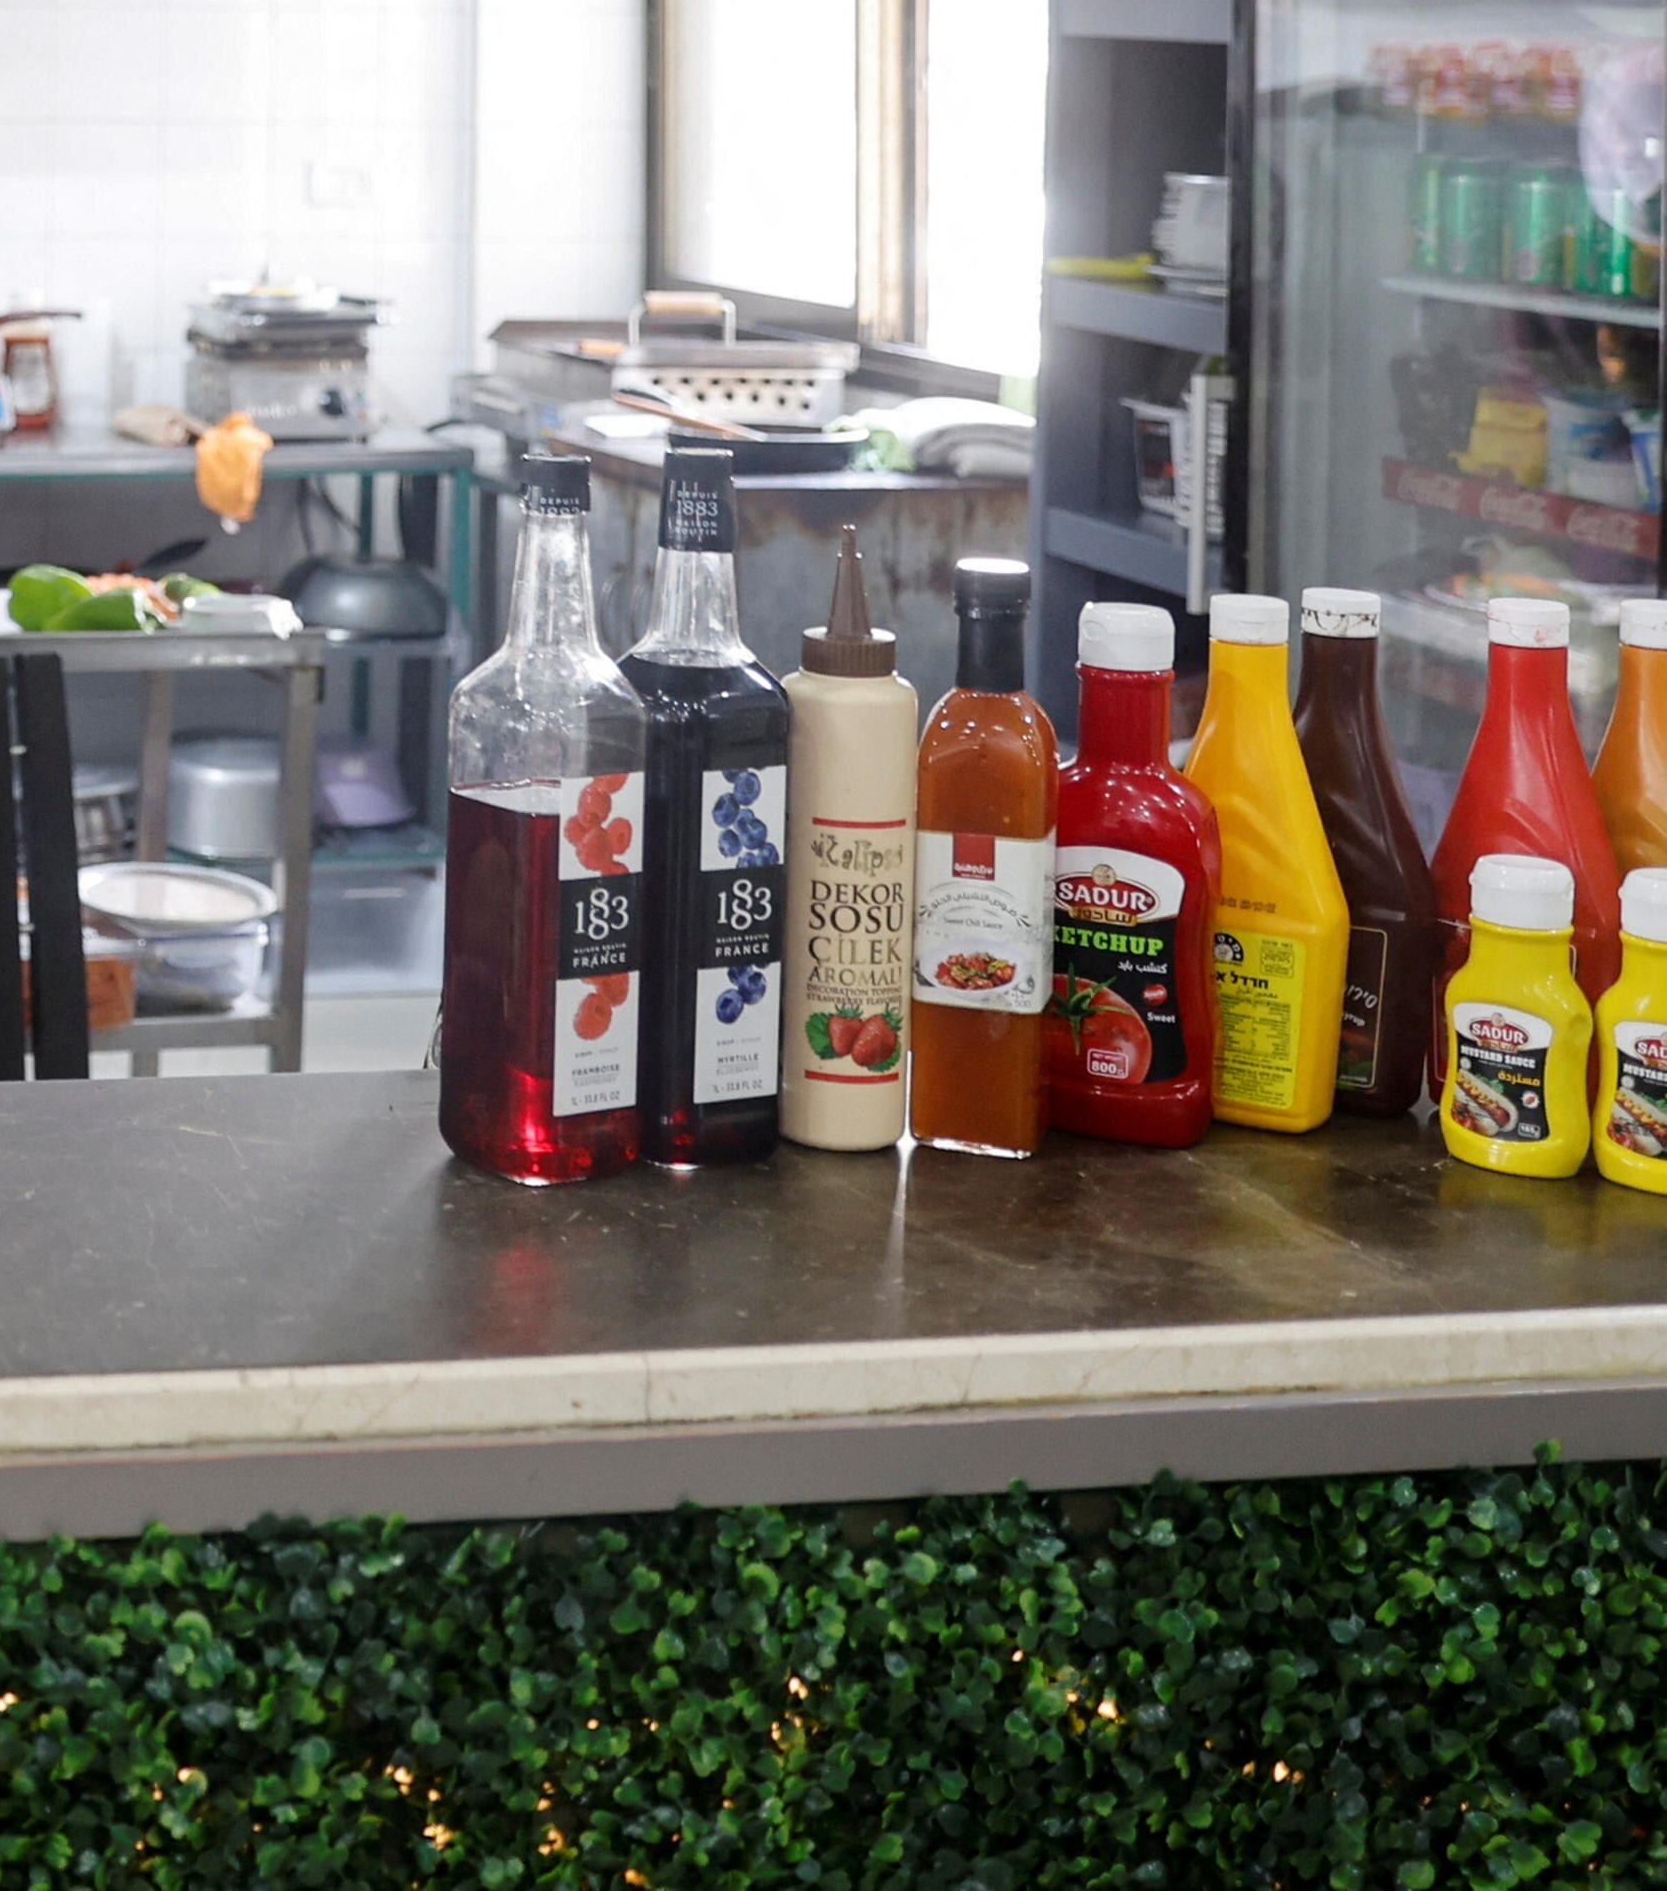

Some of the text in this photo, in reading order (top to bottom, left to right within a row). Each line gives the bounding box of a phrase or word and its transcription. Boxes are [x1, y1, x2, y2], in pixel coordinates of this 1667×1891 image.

[677, 501, 718, 517] 1883
[810, 879, 905, 905] DEKOR
[1058, 881, 1148, 911] SADUR
[808, 902, 905, 934] SOSU
[715, 942, 770, 958] FRANCE
[572, 952, 626, 969] FRANCE
[1230, 970, 1269, 990] חרדל
[1347, 984, 1378, 1010] סירו
[1147, 1011, 1176, 1024] Sweet
[1470, 1023, 1526, 1046] SADUR
[717, 1053, 760, 1064] MYRTILLE
[1460, 1045, 1504, 1064] MUSTARD
[1505, 1053, 1536, 1070] SAUCE
[1623, 1063, 1667, 1082] MUSTAR
